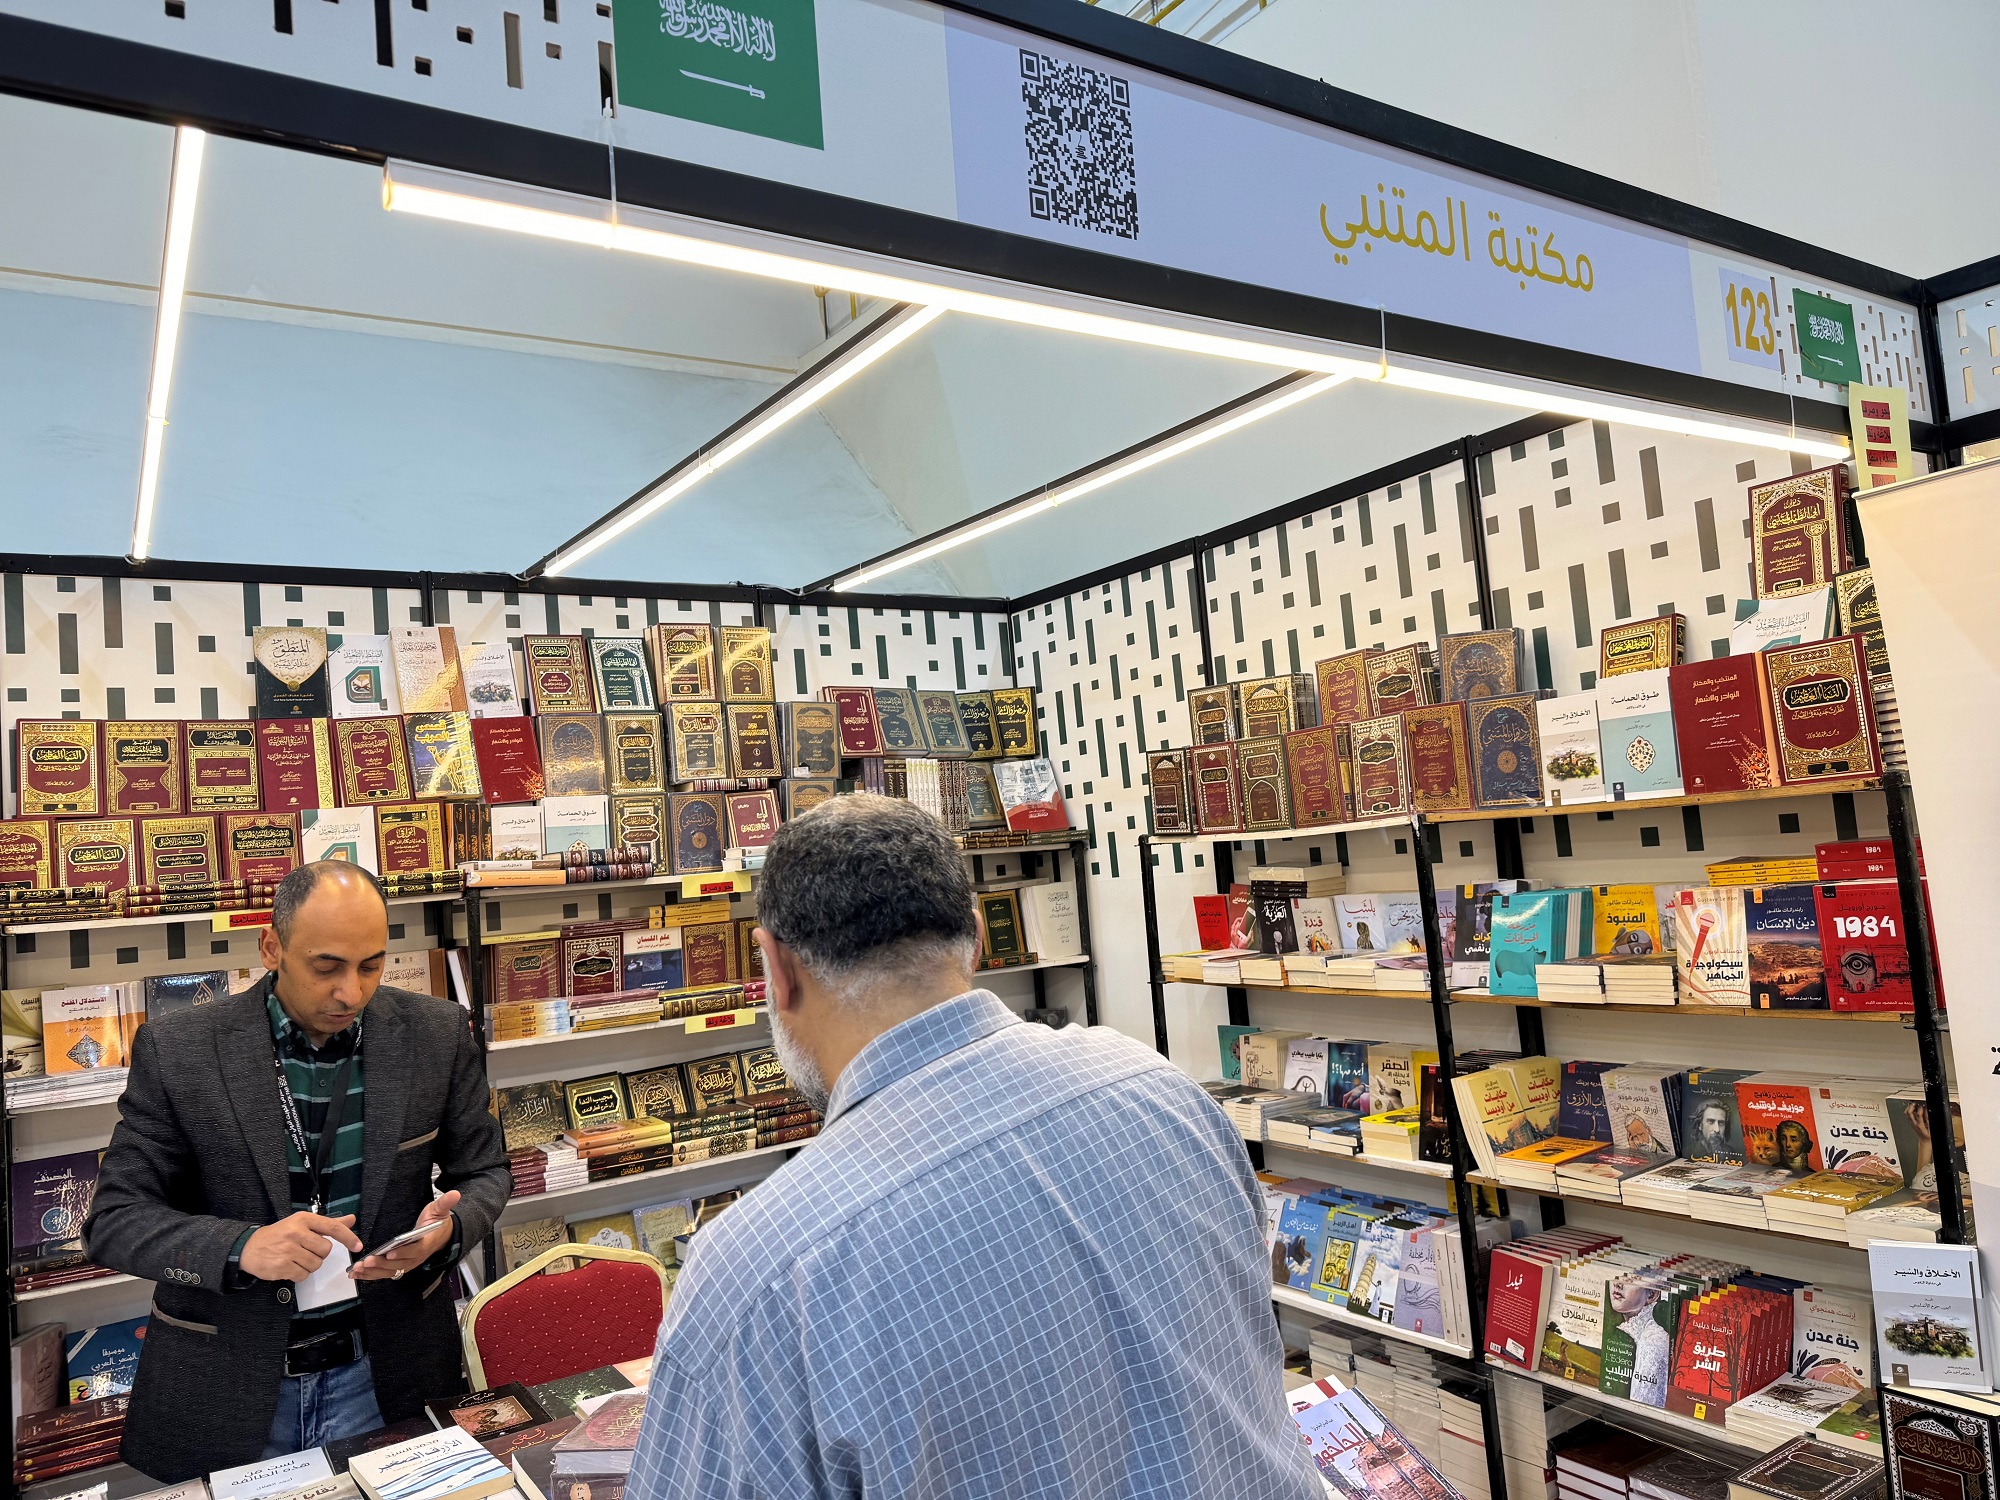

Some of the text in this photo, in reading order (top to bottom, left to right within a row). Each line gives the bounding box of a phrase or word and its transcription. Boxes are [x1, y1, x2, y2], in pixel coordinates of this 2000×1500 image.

[1320, 182, 1594, 293] مكتبة المتنبي
[1726, 283, 1775, 355] 123
[415, 731, 449, 744] العرب
[1865, 846, 1882, 854] 1984
[1867, 864, 1884, 872] 1984
[1606, 912, 1646, 926] المنبوذ
[1832, 915, 1897, 939] 1984
[637, 934, 658, 944] اللسان
[1705, 971, 1744, 981] الجماهير
[1381, 1060, 1410, 1072] الصقر
[1829, 1124, 1889, 1144] جنة عدن
[1924, 1266, 1962, 1279] الأخلاق
[1561, 1308, 1586, 1320] الطلاق
[1806, 1327, 1860, 1352] جنة عدن
[1692, 1341, 1726, 1358] طريق
[1692, 1357, 1721, 1373] الشر
[1634, 1371, 1658, 1385] شجرة
